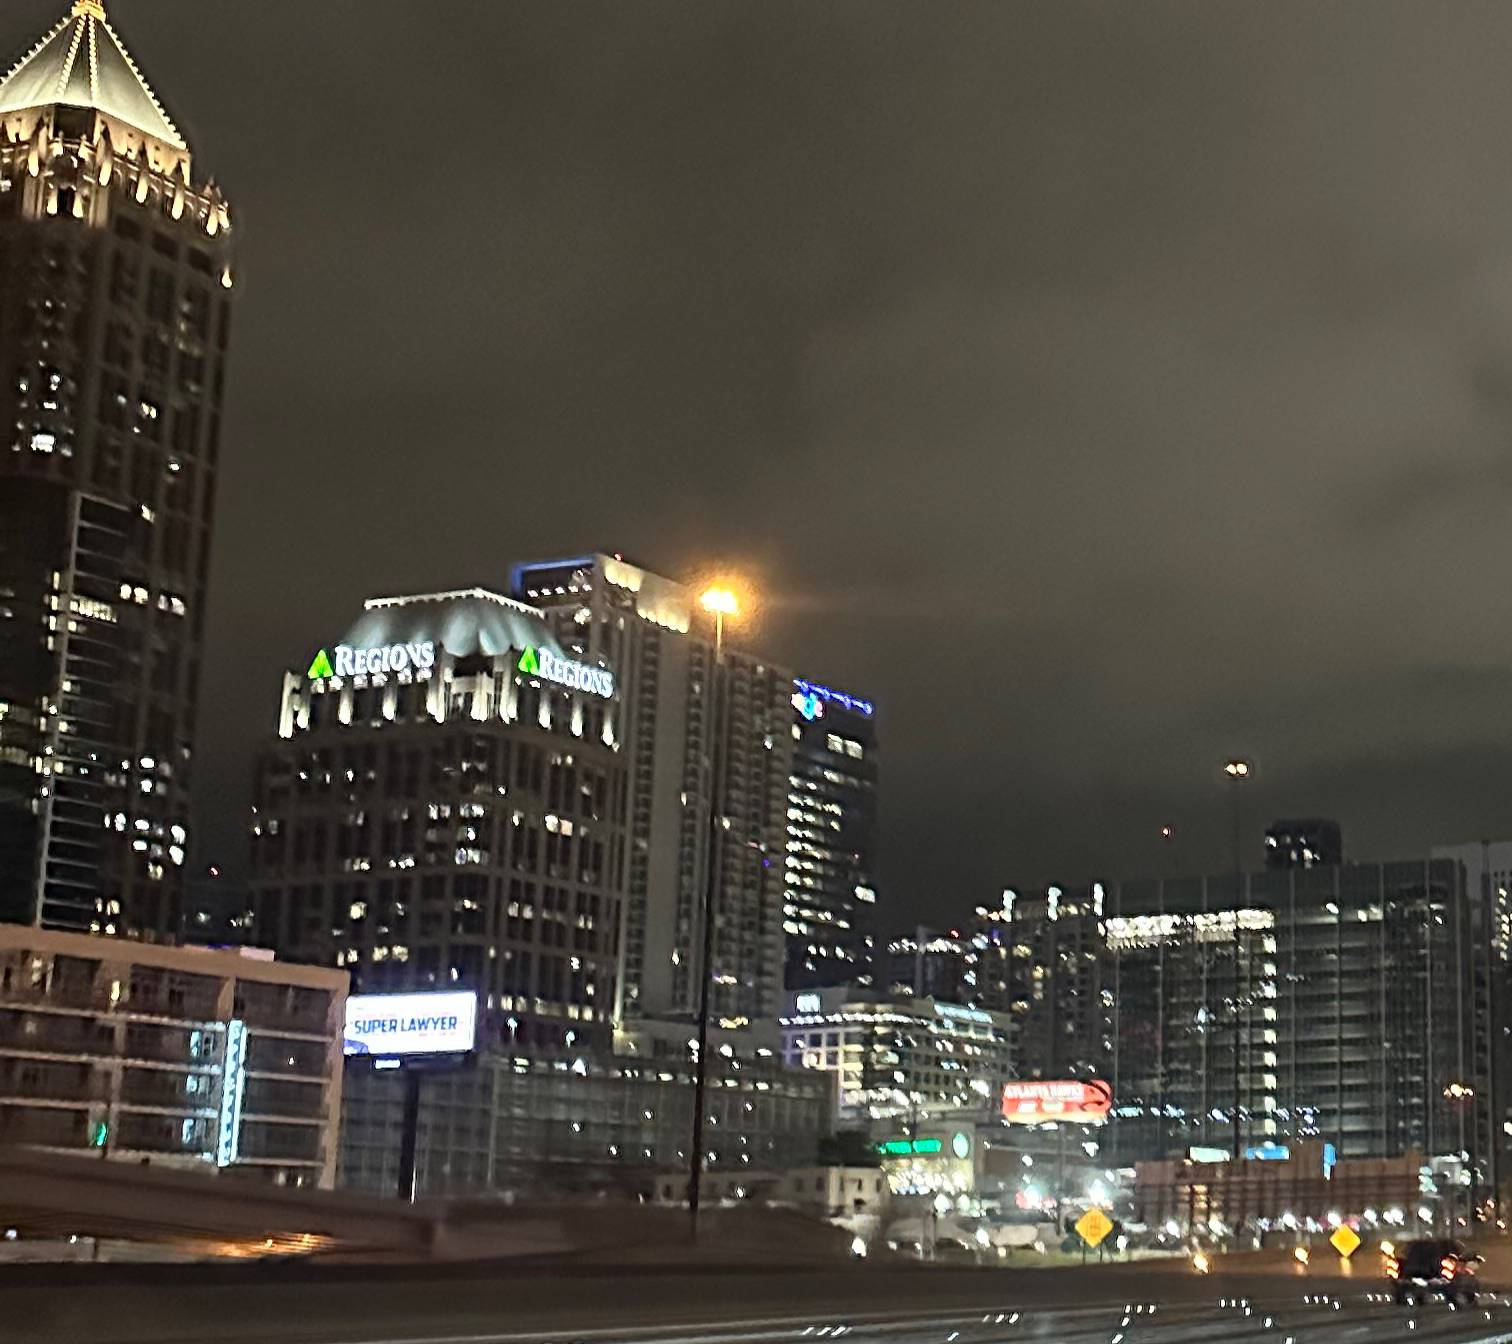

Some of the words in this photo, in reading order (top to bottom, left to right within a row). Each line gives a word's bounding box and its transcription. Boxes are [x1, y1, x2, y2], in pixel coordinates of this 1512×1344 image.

[335, 641, 434, 676] REGIONS
[538, 646, 613, 698] REGIONS
[354, 1018, 398, 1034] SUPER
[400, 1016, 457, 1032] LAWYER
